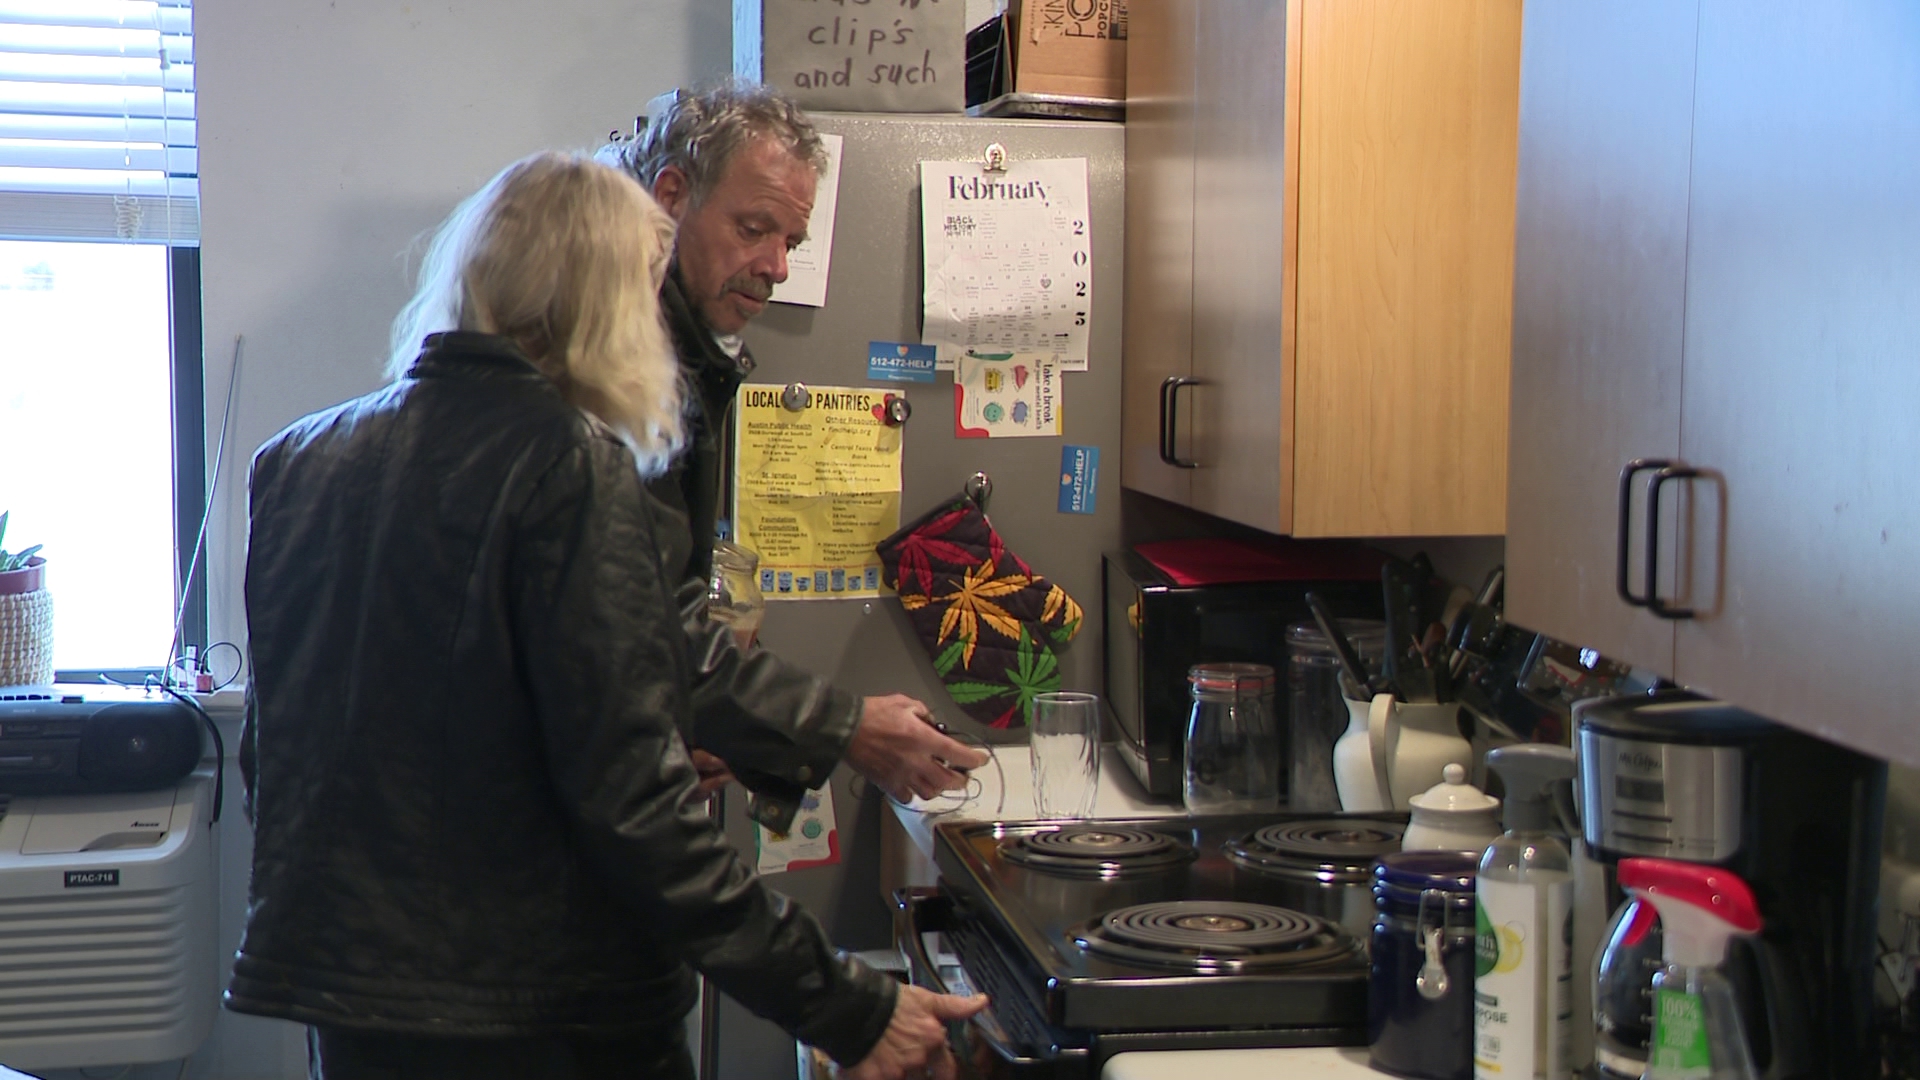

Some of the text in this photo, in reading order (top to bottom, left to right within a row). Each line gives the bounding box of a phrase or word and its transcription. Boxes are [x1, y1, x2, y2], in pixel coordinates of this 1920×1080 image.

[808, 16, 914, 54] clip's
[1097, 0, 1109, 39] POPC
[794, 49, 936, 89] and such
[948, 175, 1052, 208] February
[870, 356, 934, 369] 512-472-HELP
[1043, 364, 1054, 386] take
[746, 391, 781, 408] LOCAL
[816, 393, 870, 412] PANTRIES
[1043, 395, 1054, 424] break
[848, 416, 883, 427] Resourc
[1071, 449, 1085, 511] 512-472-HELP
